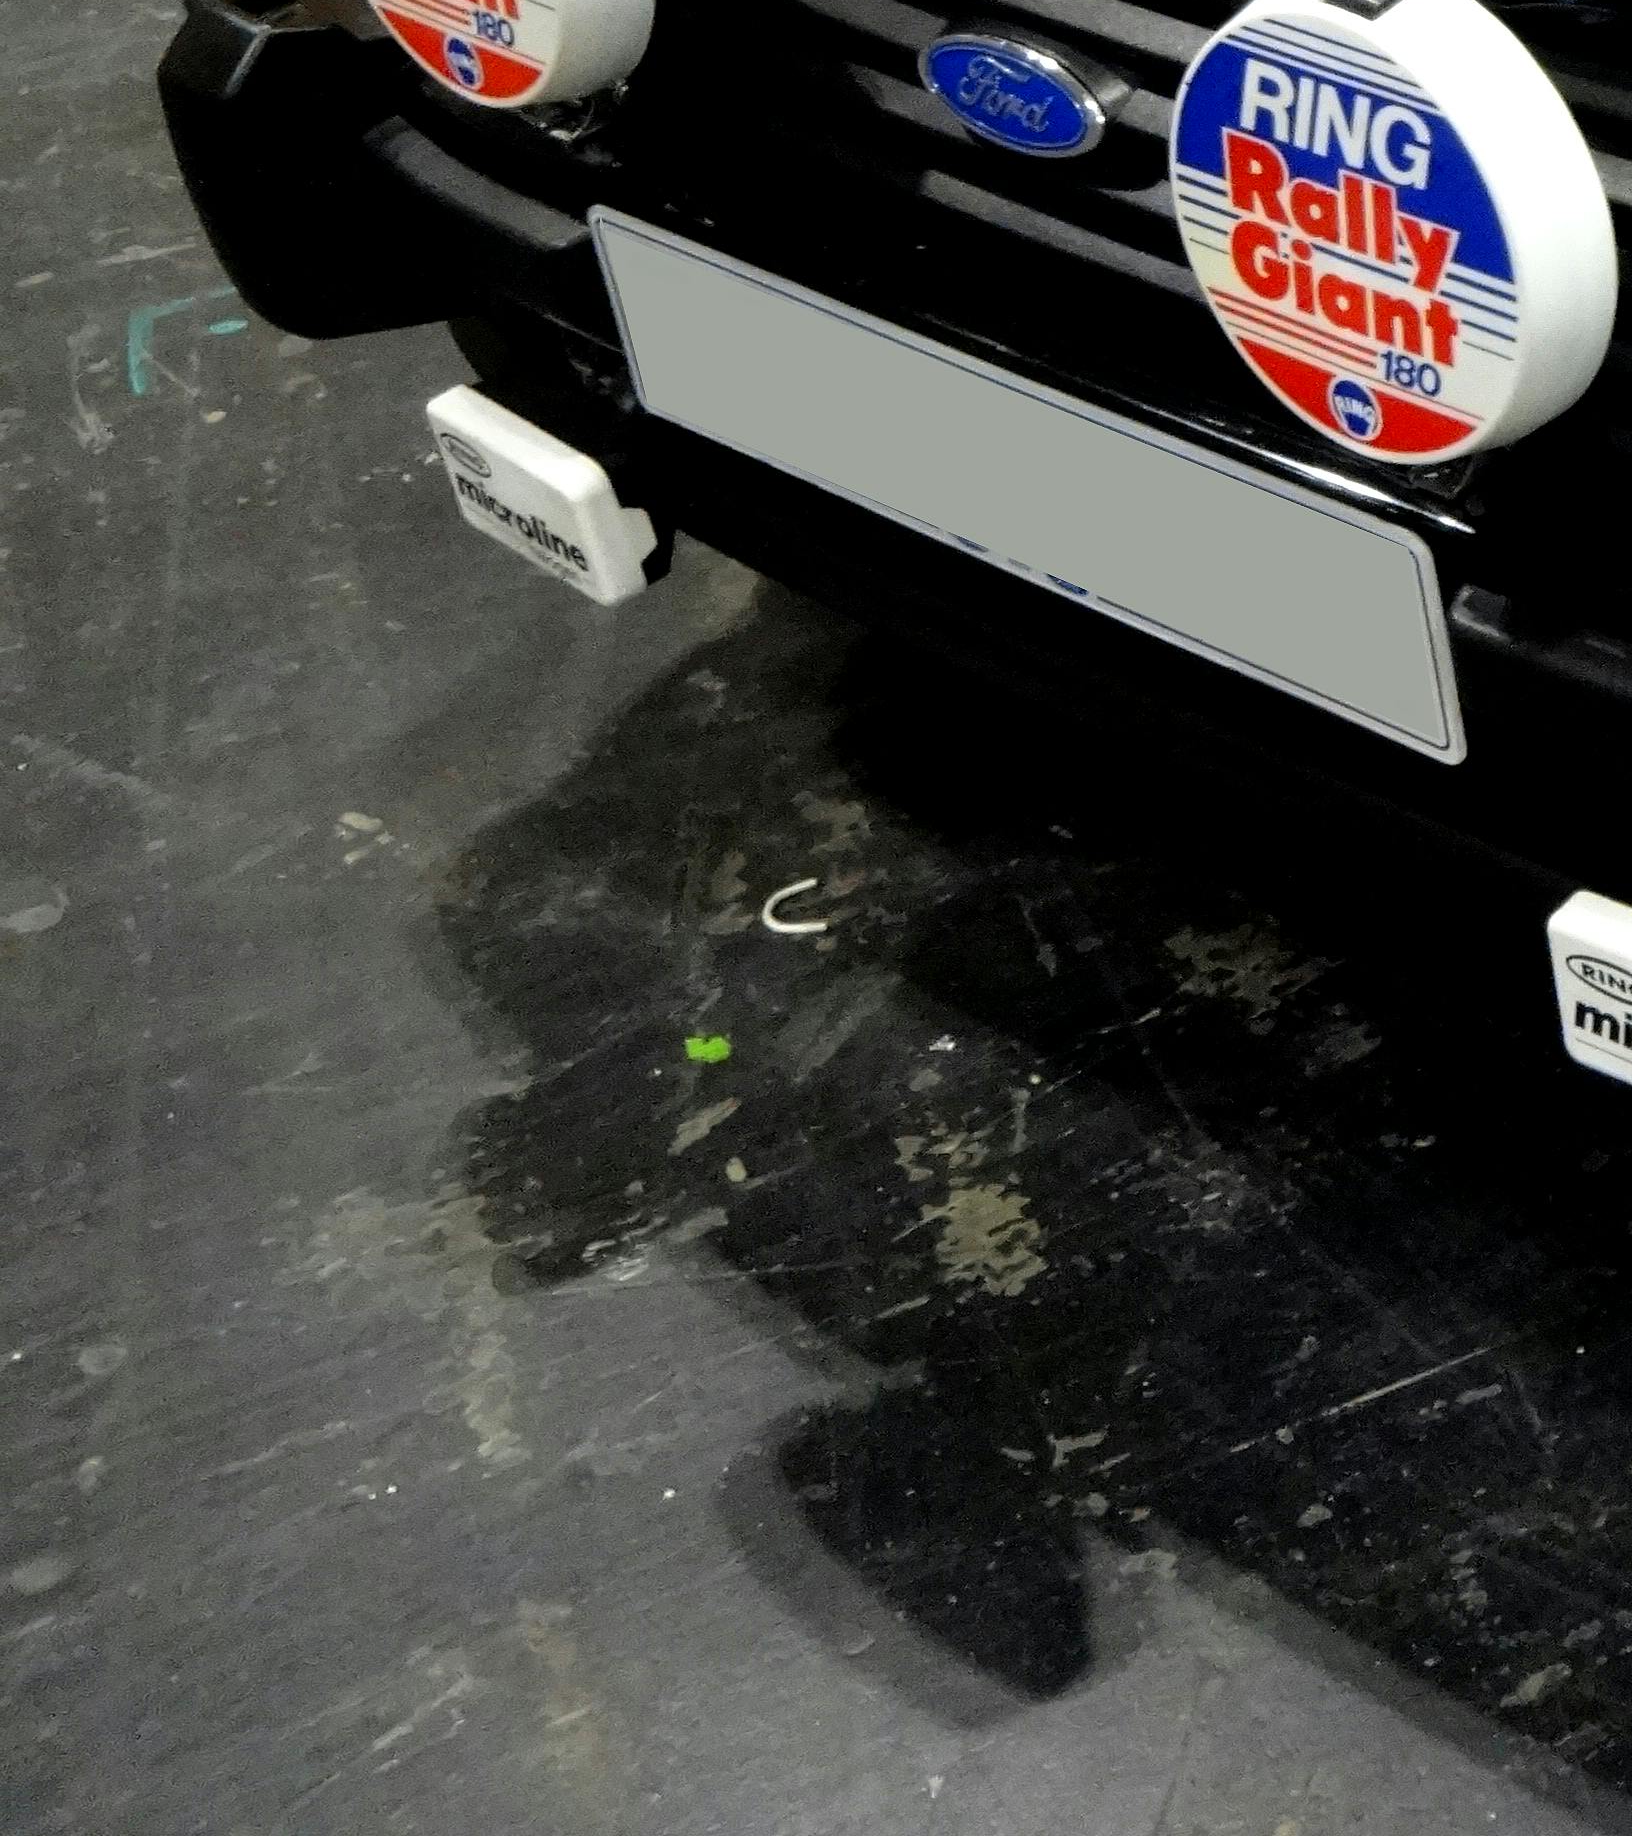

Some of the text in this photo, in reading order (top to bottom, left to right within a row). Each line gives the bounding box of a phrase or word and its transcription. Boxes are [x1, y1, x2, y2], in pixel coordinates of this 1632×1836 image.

[472, 9, 516, 47] 180
[958, 55, 1056, 133] Ford
[1239, 60, 1431, 190] RING
[1221, 127, 1461, 294] Rally
[1228, 220, 1464, 367] Giant
[1379, 349, 1442, 397] 180
